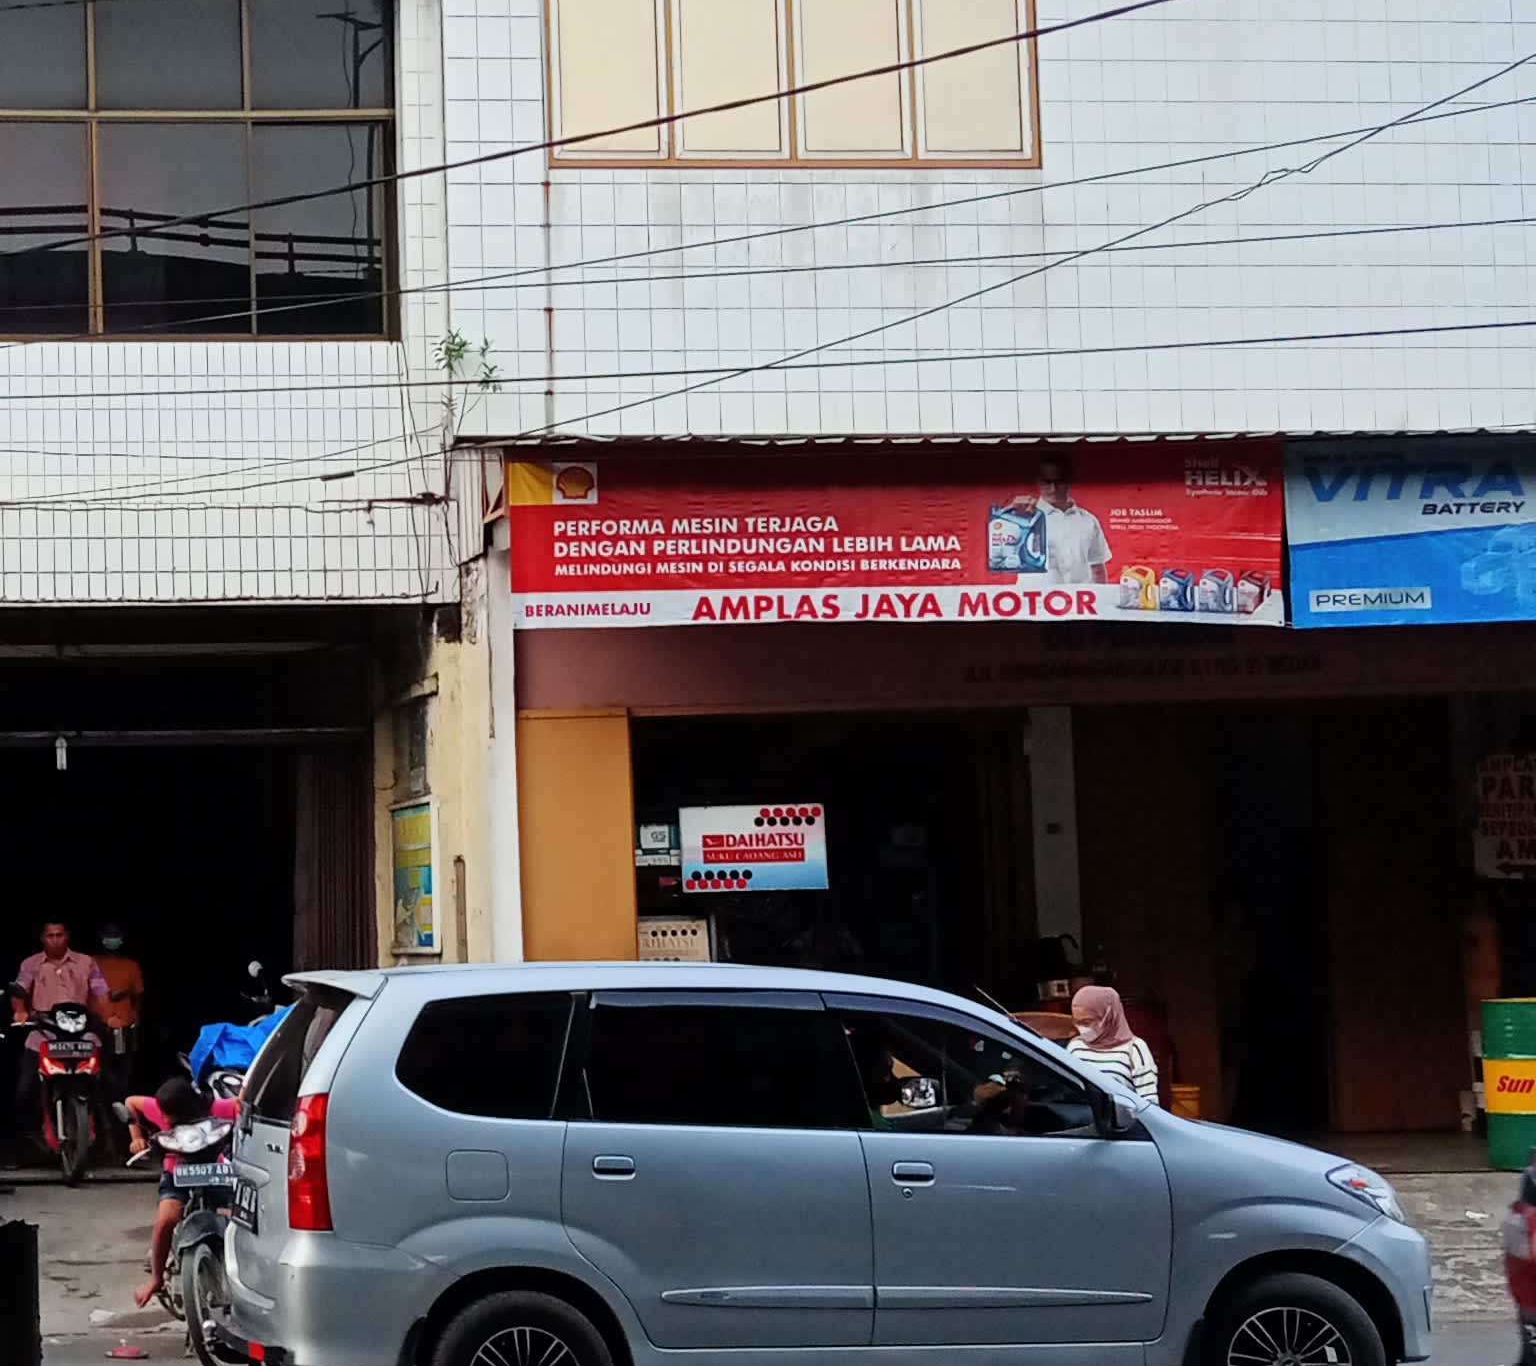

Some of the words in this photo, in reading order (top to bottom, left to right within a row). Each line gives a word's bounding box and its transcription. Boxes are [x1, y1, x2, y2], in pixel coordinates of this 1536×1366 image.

[1185, 467, 1268, 486] HELIX
[1305, 462, 1526, 503] VITRA
[1109, 508, 1127, 516] JOE
[1129, 508, 1163, 516] TASLIM
[1421, 501, 1526, 516] BATTERY
[553, 518, 665, 537] PERFORMA
[671, 517, 738, 535] MESIN
[744, 515, 839, 533] TERJAGA
[553, 540, 646, 558] DENGAN
[653, 537, 825, 556] PERLINDUNGAN
[833, 536, 894, 553] LEBIH
[900, 536, 961, 552] LAMA
[554, 563, 651, 576] MELINDUNGI
[656, 562, 703, 574] MESIN
[708, 562, 724, 573] DI
[729, 561, 786, 574] SEGALA
[791, 560, 856, 572] KONDISI
[860, 559, 961, 571] BERKENDARA
[692, 594, 841, 621] AMPLAS
[854, 593, 944, 620] JAYA
[958, 590, 1098, 617] MOTOR
[1316, 591, 1425, 608] PREMIUM
[525, 603, 651, 618] BERANIMELAJU
[725, 832, 805, 848] DAIHATSU
